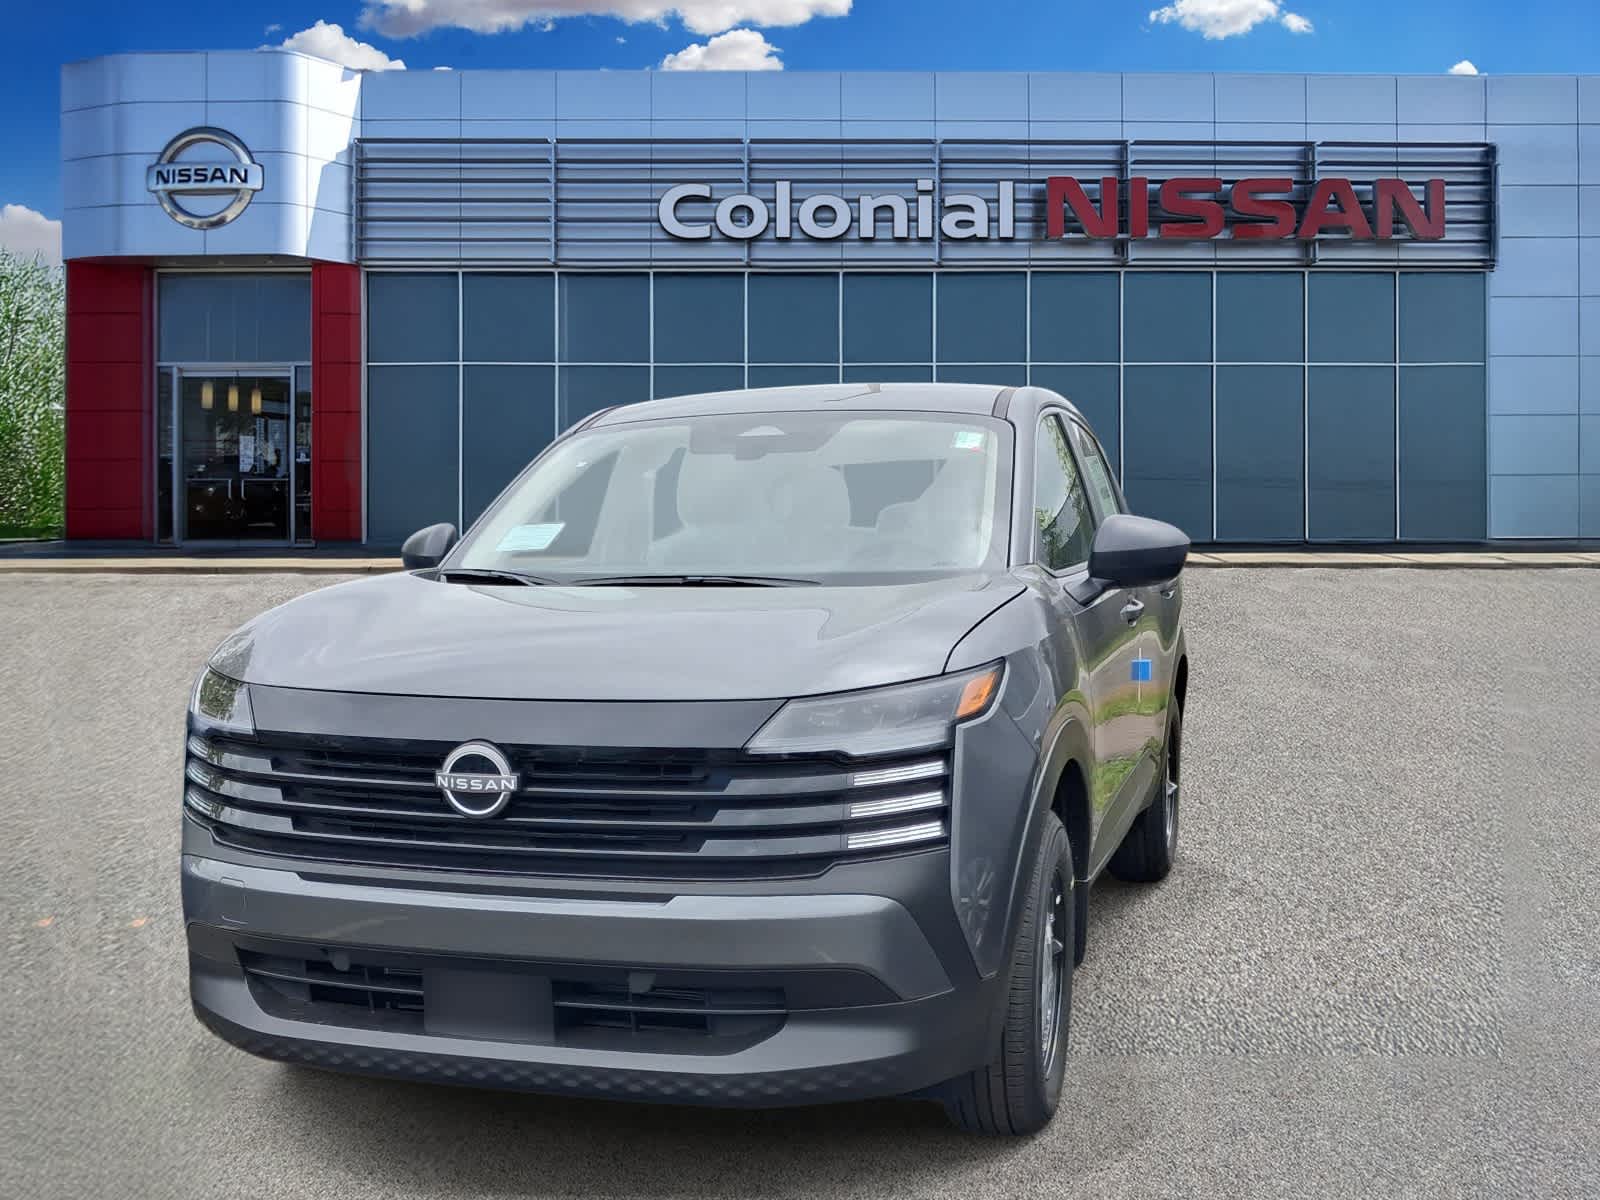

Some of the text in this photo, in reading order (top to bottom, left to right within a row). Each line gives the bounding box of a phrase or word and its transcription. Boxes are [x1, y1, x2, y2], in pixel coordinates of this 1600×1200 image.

[156, 167, 248, 185] NISSAN
[658, 176, 1446, 240] Colonial NISSAN
[437, 775, 515, 790] NISSAN
